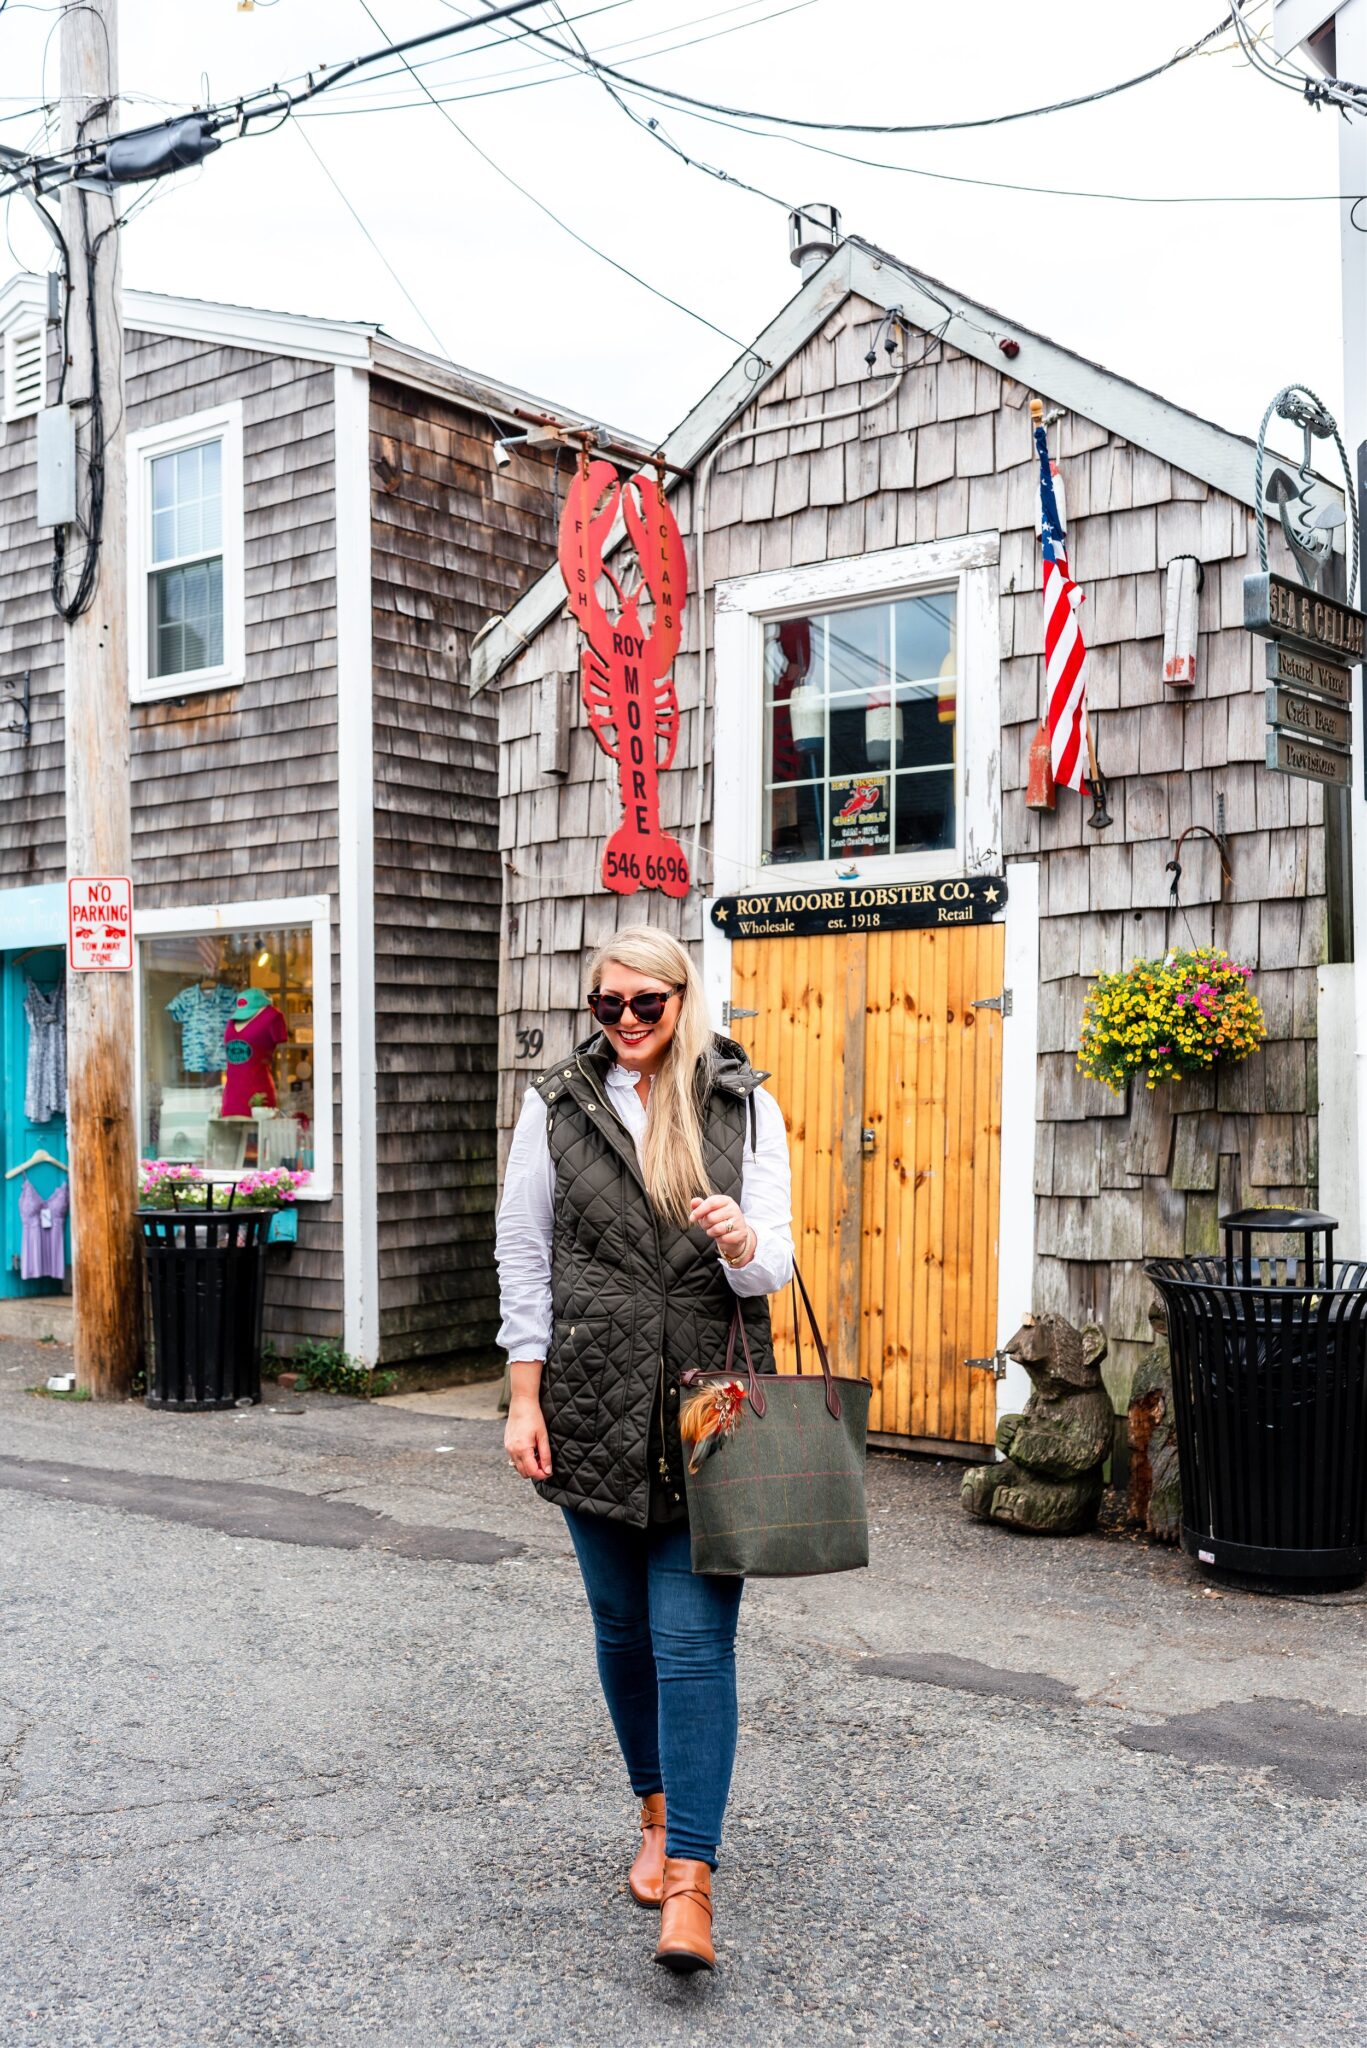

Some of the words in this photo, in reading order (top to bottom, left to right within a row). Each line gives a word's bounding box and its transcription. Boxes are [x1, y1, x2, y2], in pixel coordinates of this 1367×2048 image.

[574, 520, 588, 607] FISH
[659, 524, 673, 629] CLAMS
[1269, 582, 1297, 629] SEA
[1301, 596, 1311, 638] &
[1314, 601, 1364, 655] CELLAR
[612, 632, 645, 659] ROY
[1279, 652, 1314, 684] Natural
[1317, 665, 1344, 693] Wine
[624, 664, 651, 835] MOORE
[1286, 743, 1337, 777] Provisions
[606, 851, 641, 880] 546
[645, 855, 688, 884] 6696
[88, 886, 111, 902] NO
[736, 897, 774, 917] ROY
[775, 890, 846, 914] MOORE
[850, 885, 936, 908] LOBSTER
[939, 881, 975, 901] CO.
[73, 904, 128, 922] PARKING
[738, 919, 796, 935] Wholesale
[827, 916, 847, 930] est.
[851, 913, 881, 929] 1918
[937, 905, 974, 922] Retail
[82, 943, 97, 951] TOW
[101, 942, 121, 951] AWAY
[90, 952, 112, 963] ZONE
[515, 1026, 544, 1060] 39
